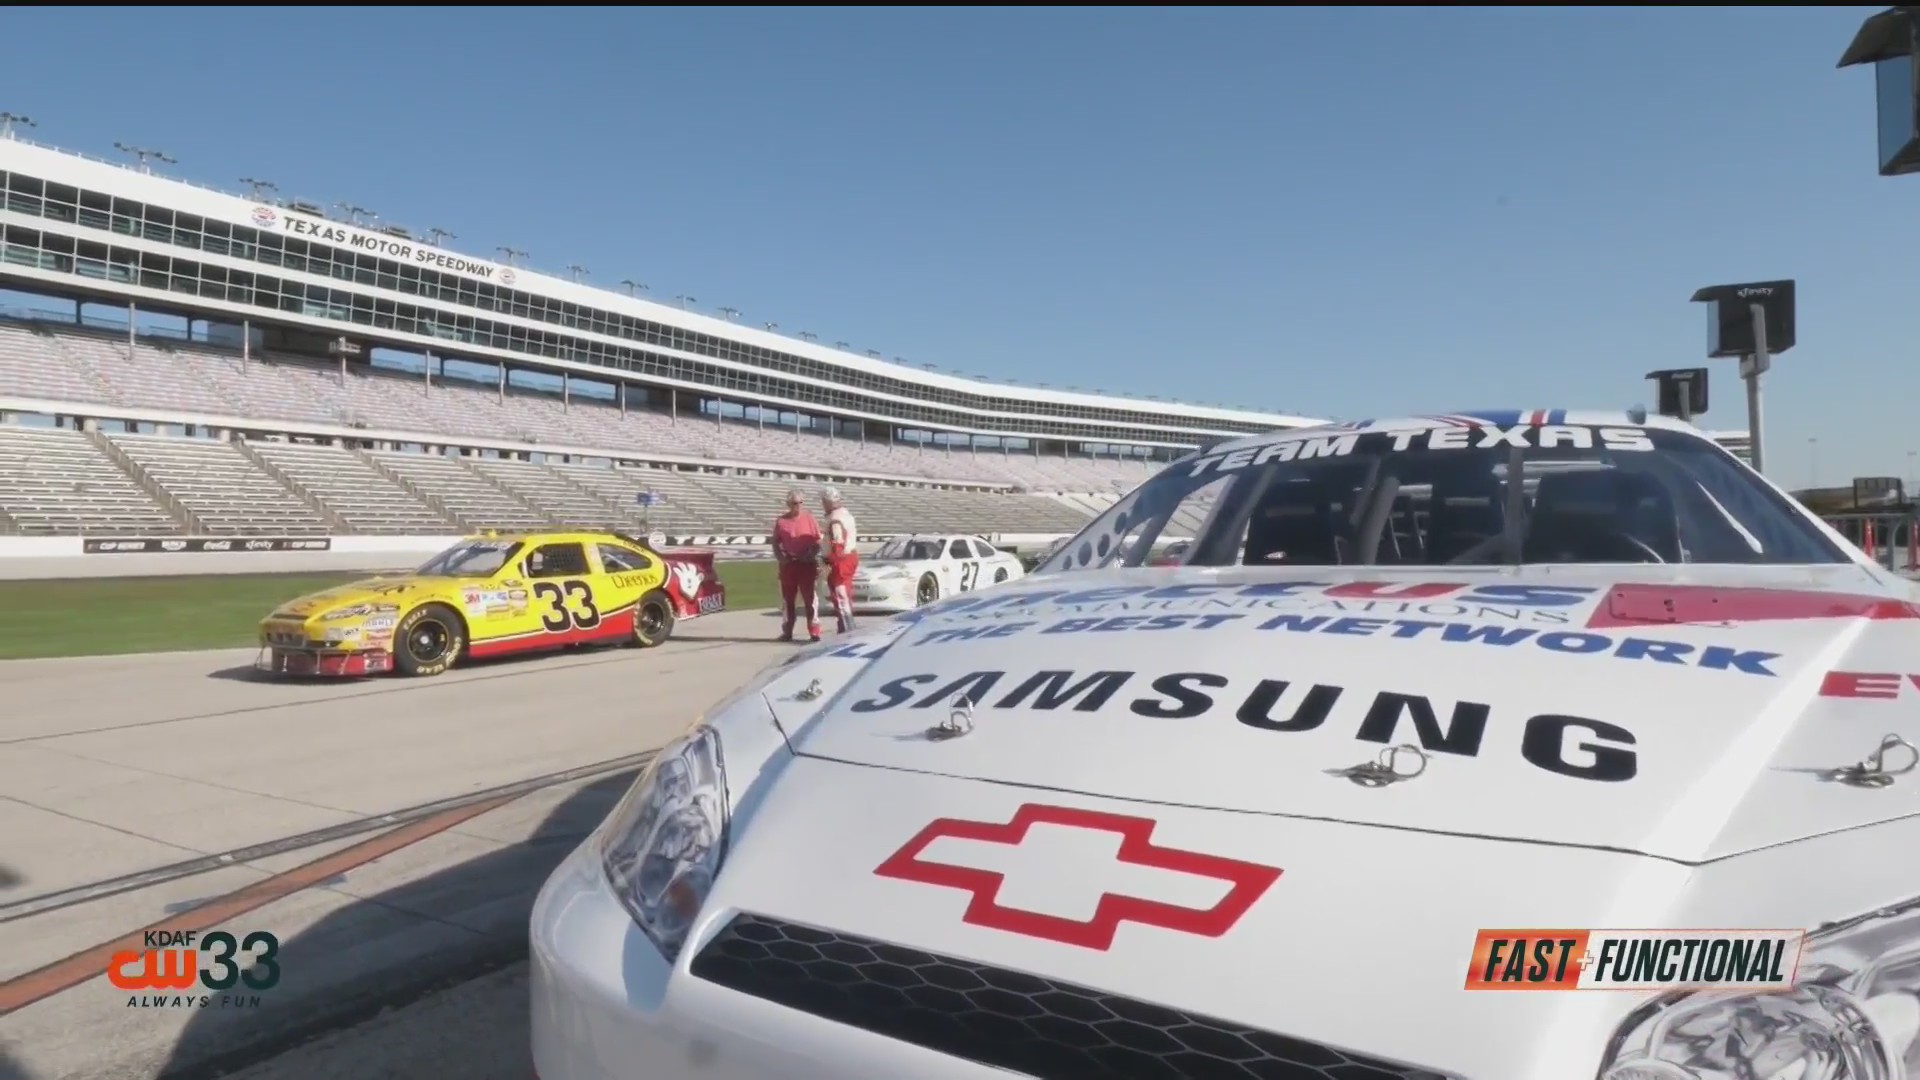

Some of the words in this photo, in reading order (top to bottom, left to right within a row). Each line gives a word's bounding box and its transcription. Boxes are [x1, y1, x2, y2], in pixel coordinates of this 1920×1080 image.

[284, 216, 346, 243] TEXAS
[350, 233, 412, 259] MOTOR
[415, 249, 494, 278] SPEEDWAY
[1188, 432, 1361, 477] TEAM
[1385, 425, 1655, 452] TEXAS
[675, 536, 767, 545] TEXAS
[960, 561, 980, 592] 27
[533, 580, 601, 632] 33
[913, 621, 1038, 646] THE
[1040, 614, 1246, 635] BEST
[1256, 614, 1784, 678] NETWORK
[1817, 671, 1920, 699] E
[850, 670, 1637, 782] SAMSUNG
